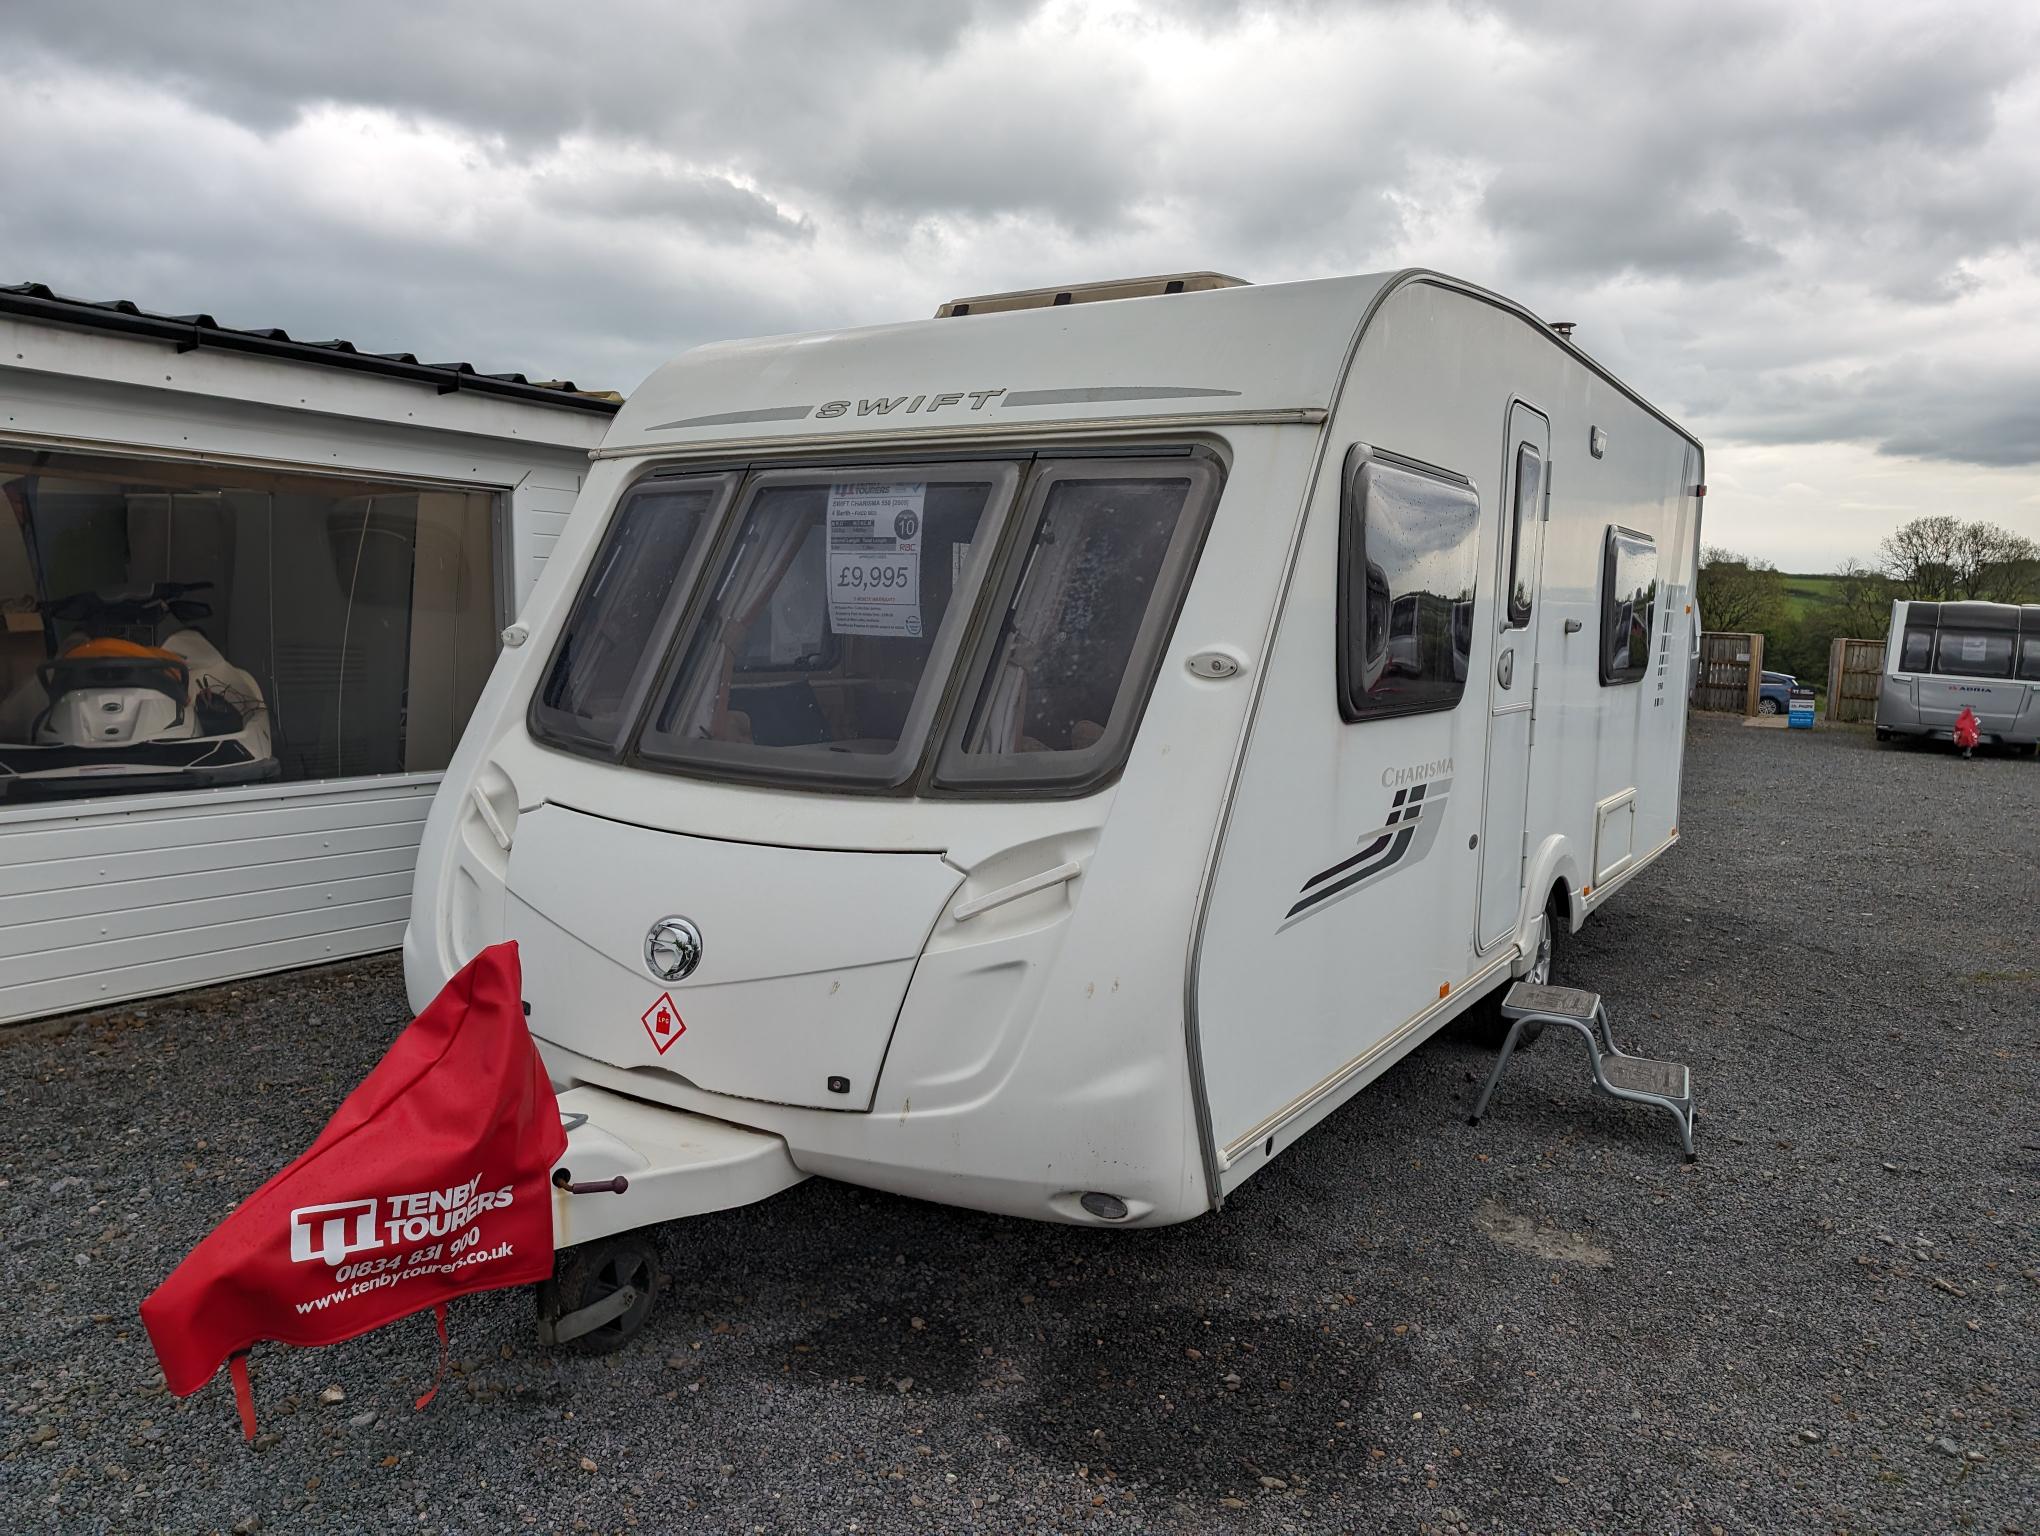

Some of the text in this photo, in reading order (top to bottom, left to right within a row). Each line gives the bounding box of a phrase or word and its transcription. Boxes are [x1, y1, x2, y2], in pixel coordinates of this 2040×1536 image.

[815, 388, 1007, 419] SWIFT
[898, 520, 915, 535] 10
[837, 566, 908, 591] £9,995
[1381, 757, 1454, 788] CHARISMA
[658, 1016, 669, 1024] LPG
[387, 1172, 483, 1218] TENBY
[384, 1185, 514, 1245] TOURERS
[335, 1226, 480, 1283] 01834 831 900
[295, 1242, 513, 1314] www.tenbytourers.co.uk
